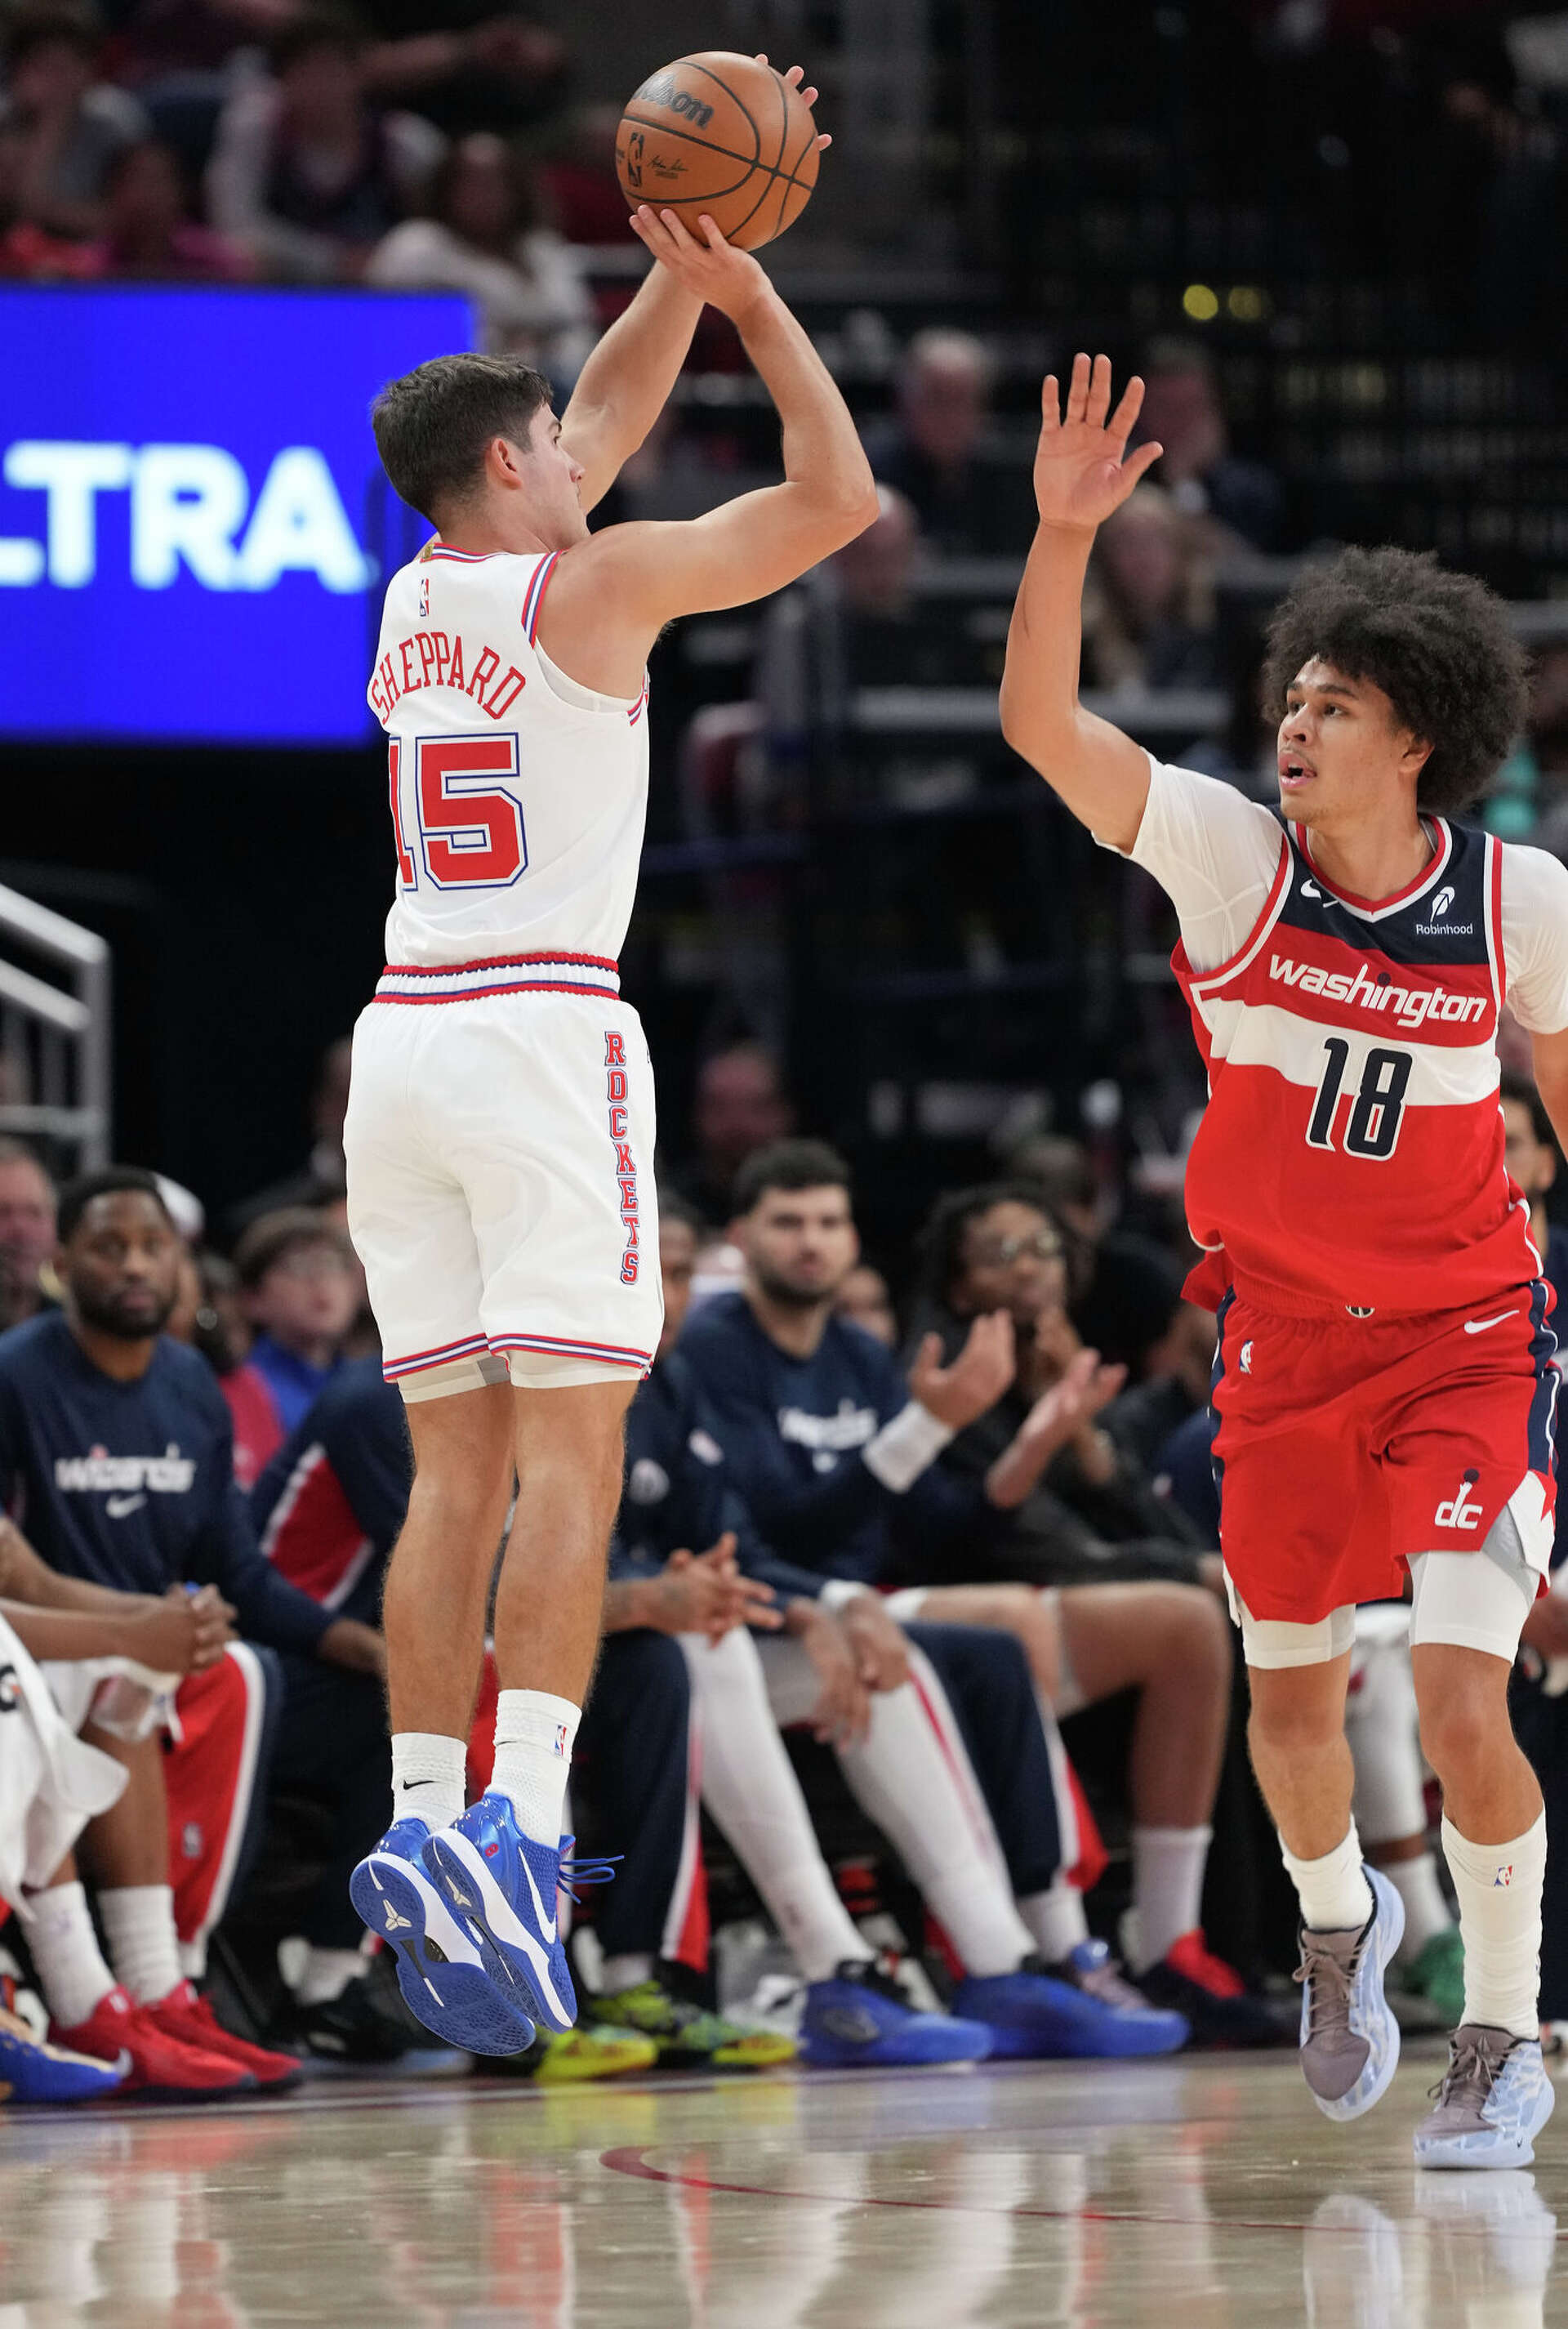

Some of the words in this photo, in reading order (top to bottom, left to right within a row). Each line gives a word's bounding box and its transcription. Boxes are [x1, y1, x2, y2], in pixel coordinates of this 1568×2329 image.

[371, 631, 526, 725] SHEPPARD
[388, 732, 528, 891] 15
[1415, 923, 1473, 935] Robinhood
[1268, 954, 1488, 1028] washington
[1306, 1035, 1414, 1162] 18
[604, 1031, 640, 1285] ROCKETS
